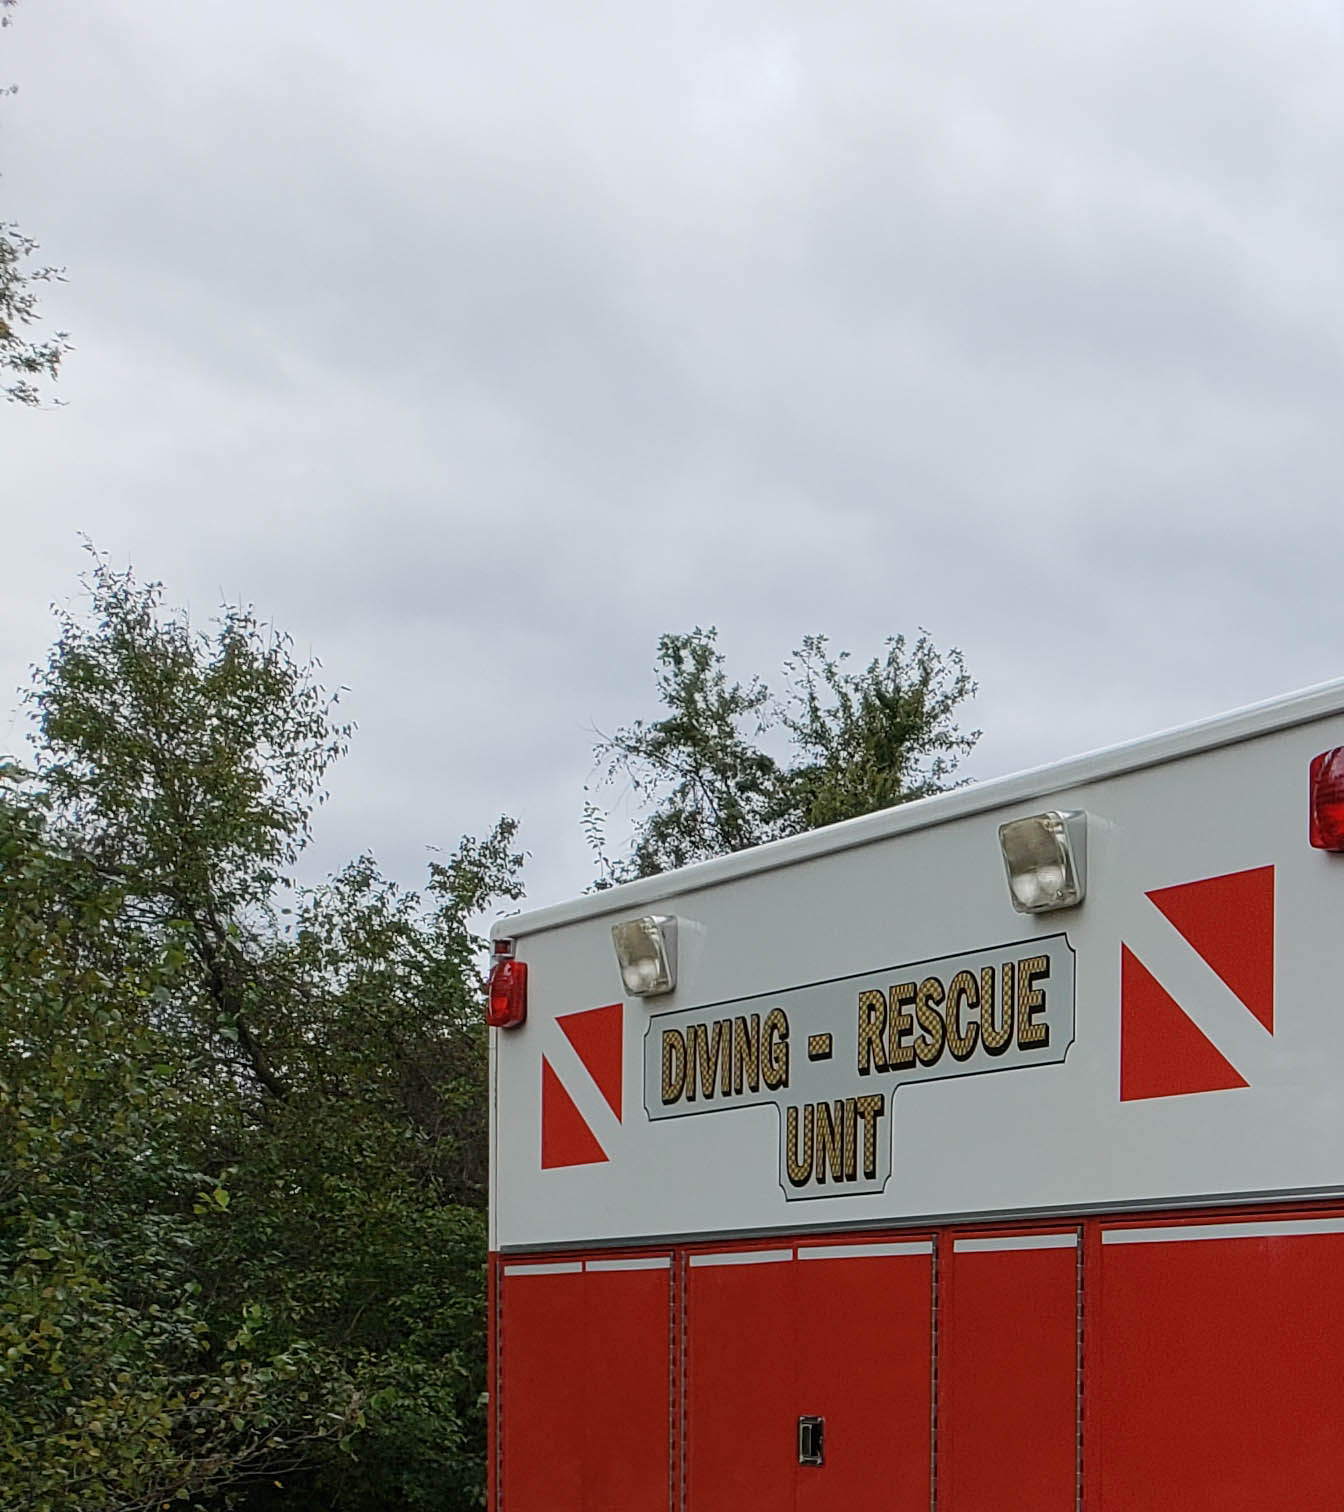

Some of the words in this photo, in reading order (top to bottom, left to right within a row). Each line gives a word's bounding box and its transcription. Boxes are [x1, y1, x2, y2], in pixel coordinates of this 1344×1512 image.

[661, 1007, 790, 1106] DIVING
[857, 954, 1051, 1077] RESCUE
[786, 1093, 885, 1188] UNIT
